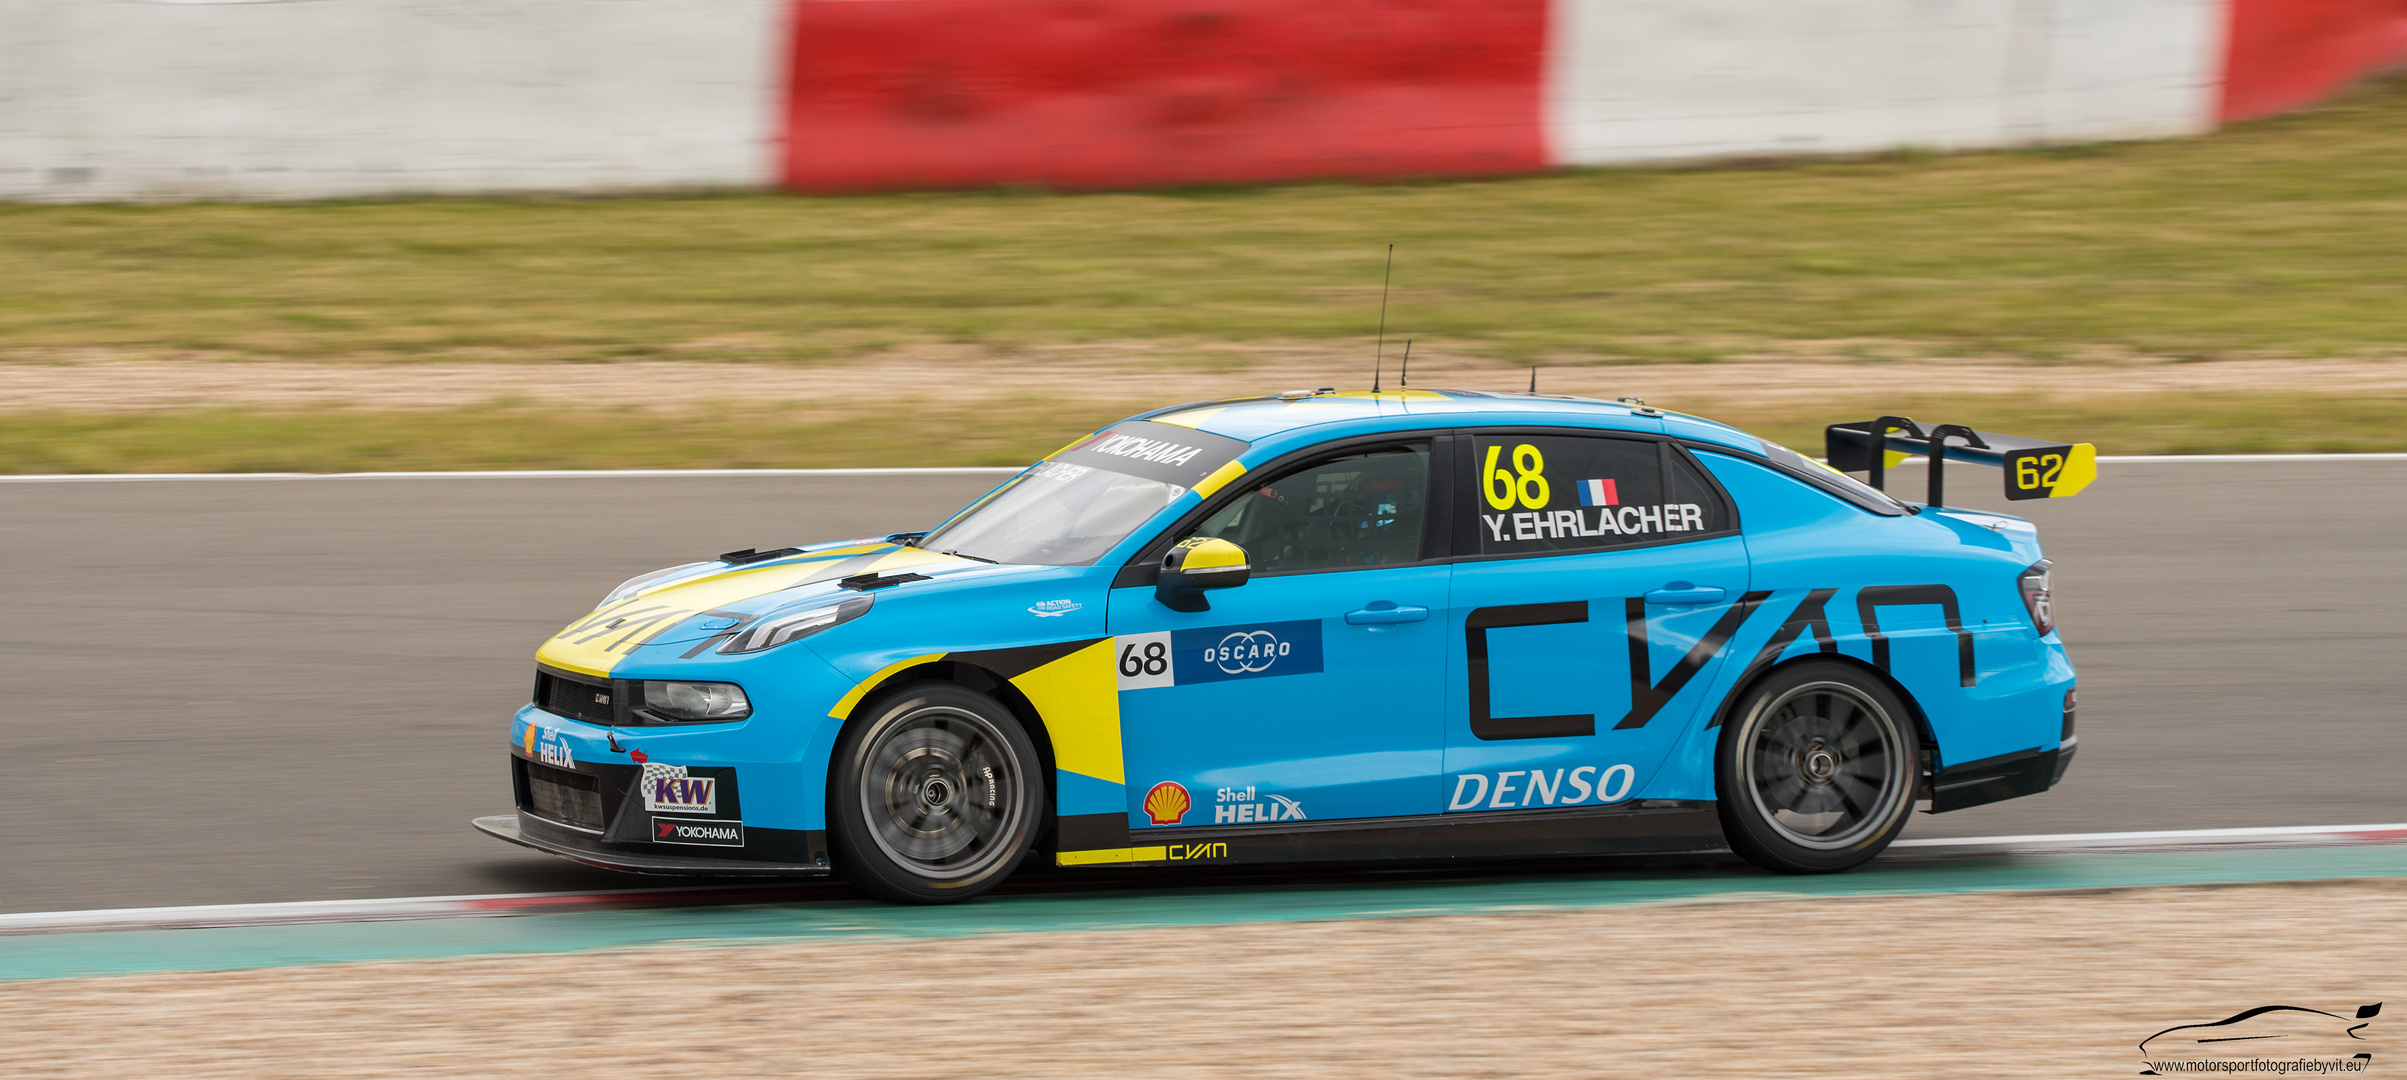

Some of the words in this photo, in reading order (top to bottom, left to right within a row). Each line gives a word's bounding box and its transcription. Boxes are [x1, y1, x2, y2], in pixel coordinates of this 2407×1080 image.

[1091, 433, 1203, 467] YOKOHAMA
[1482, 443, 1550, 511] 68
[2016, 453, 2063, 490] 62
[1046, 598, 1071, 607] ACTION
[1119, 641, 1168, 678] 68
[1204, 641, 1291, 663] OSCARO
[542, 726, 560, 742] Shell
[540, 736, 576, 770] HELIX
[655, 777, 714, 806] KW
[988, 779, 996, 807] RACING
[1216, 786, 1255, 802] Shell
[1448, 763, 1635, 811] DENSO
[653, 803, 709, 812] kwsuspensions.de
[1214, 794, 1307, 824] HELIX
[675, 825, 739, 840] YOKOHAMA
[1169, 842, 1227, 861] CYAN
